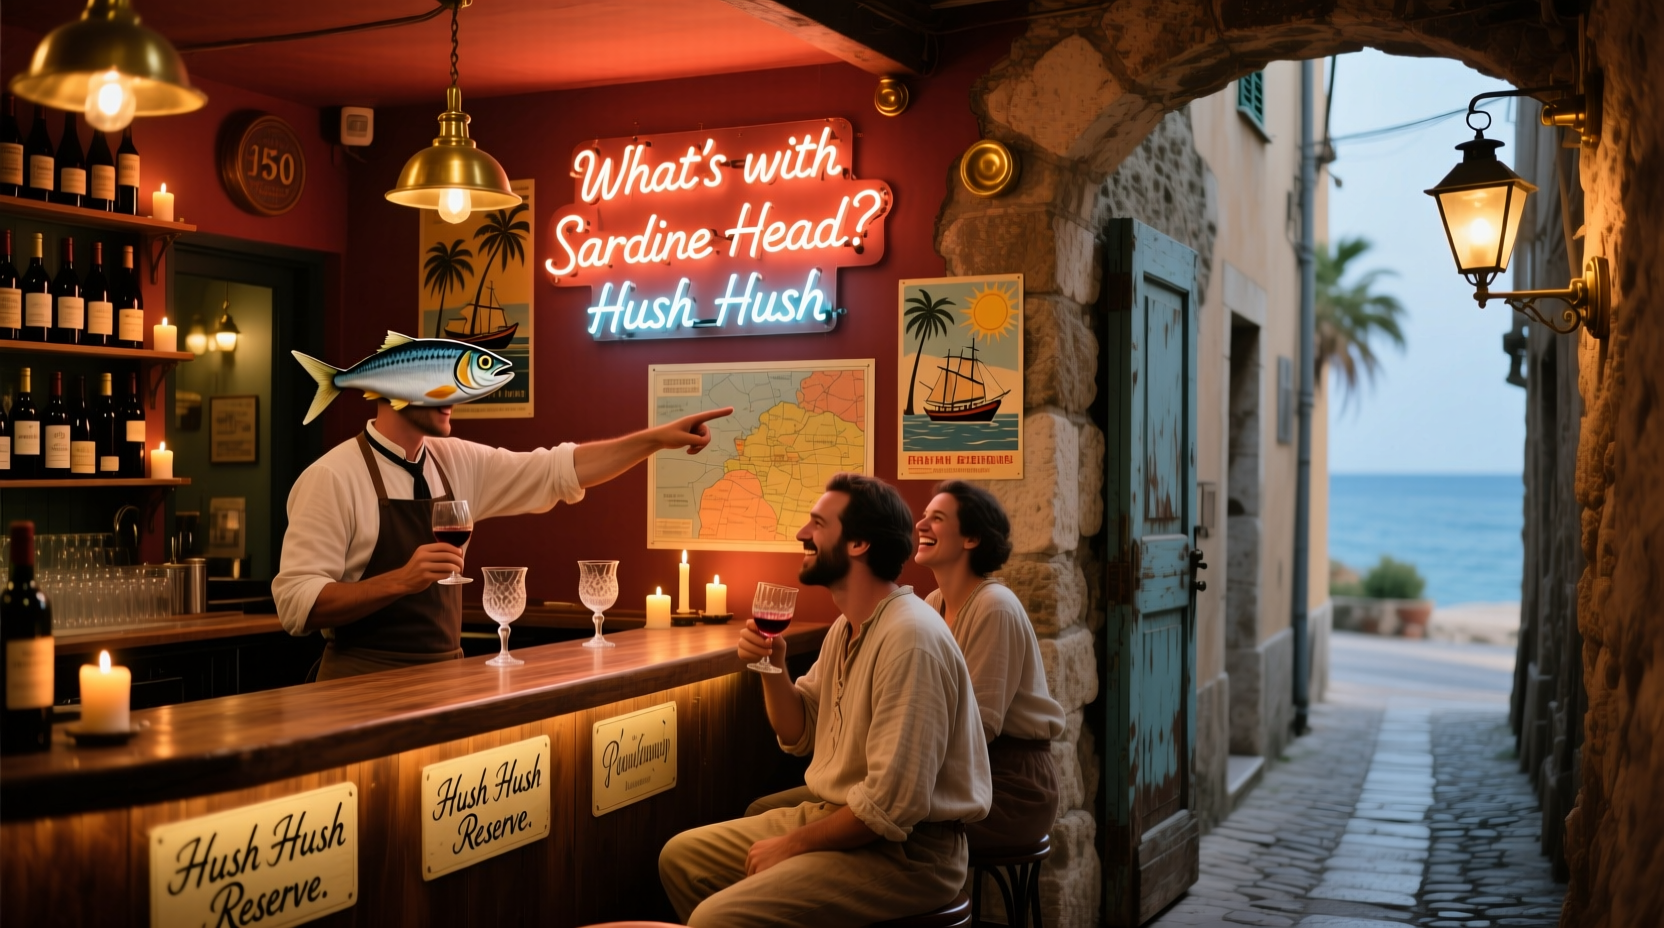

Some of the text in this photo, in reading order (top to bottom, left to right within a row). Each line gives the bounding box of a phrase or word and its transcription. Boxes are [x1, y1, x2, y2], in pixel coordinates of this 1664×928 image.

[573, 126, 842, 203] What's with
[545, 188, 882, 277] Sardine Head?
[587, 267, 827, 335] Hush Hush
[432, 767, 490, 821] Hush
[493, 752, 542, 802] Hush
[167, 801, 346, 896] Hush Hush
[452, 810, 532, 855] Reserve.
[202, 876, 328, 928] Reserve.
